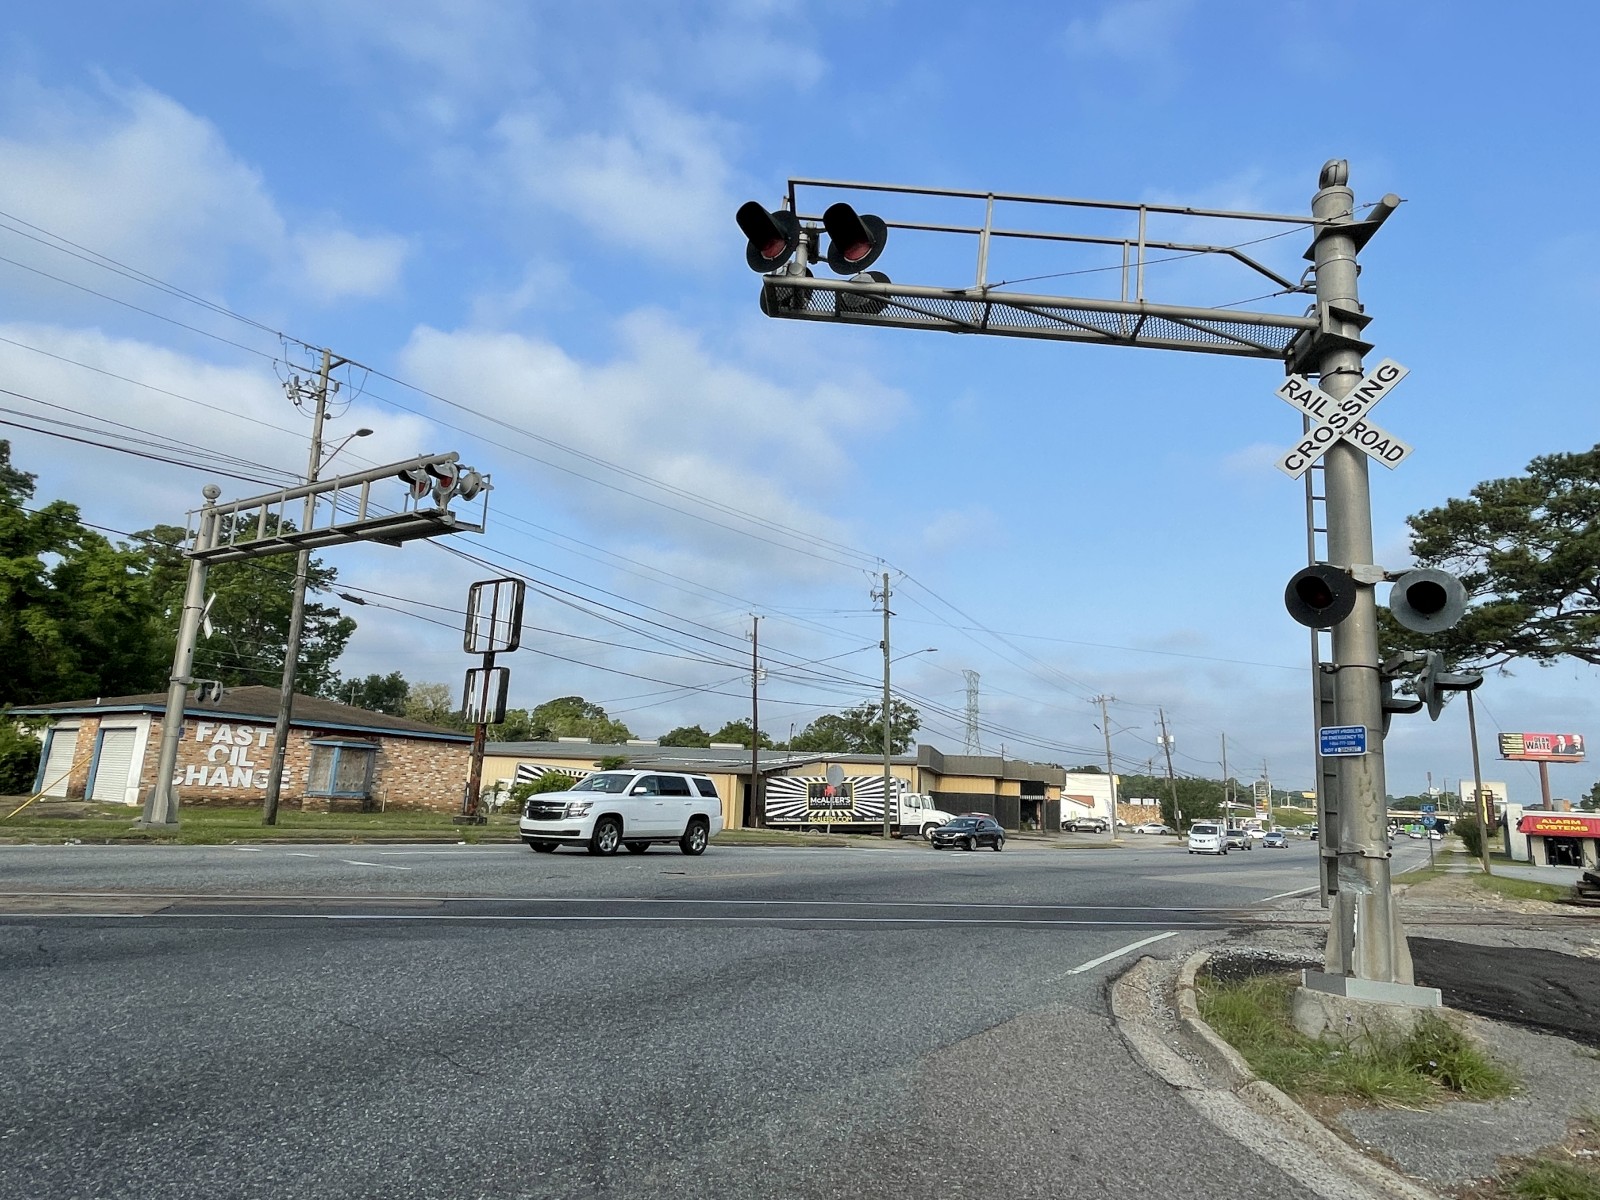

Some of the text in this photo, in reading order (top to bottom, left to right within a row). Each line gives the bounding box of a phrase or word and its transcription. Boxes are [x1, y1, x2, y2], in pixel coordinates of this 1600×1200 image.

[1280, 378, 1405, 462] RAIL ROAD
[1284, 364, 1400, 471] CROSSING
[195, 722, 274, 747] FAST
[1525, 741, 1550, 750] WAITE
[207, 744, 255, 767] OIL
[1423, 804, 1434, 812] JCT
[1423, 817, 1435, 826] 65
[1536, 824, 1589, 832] SYSTEMS
